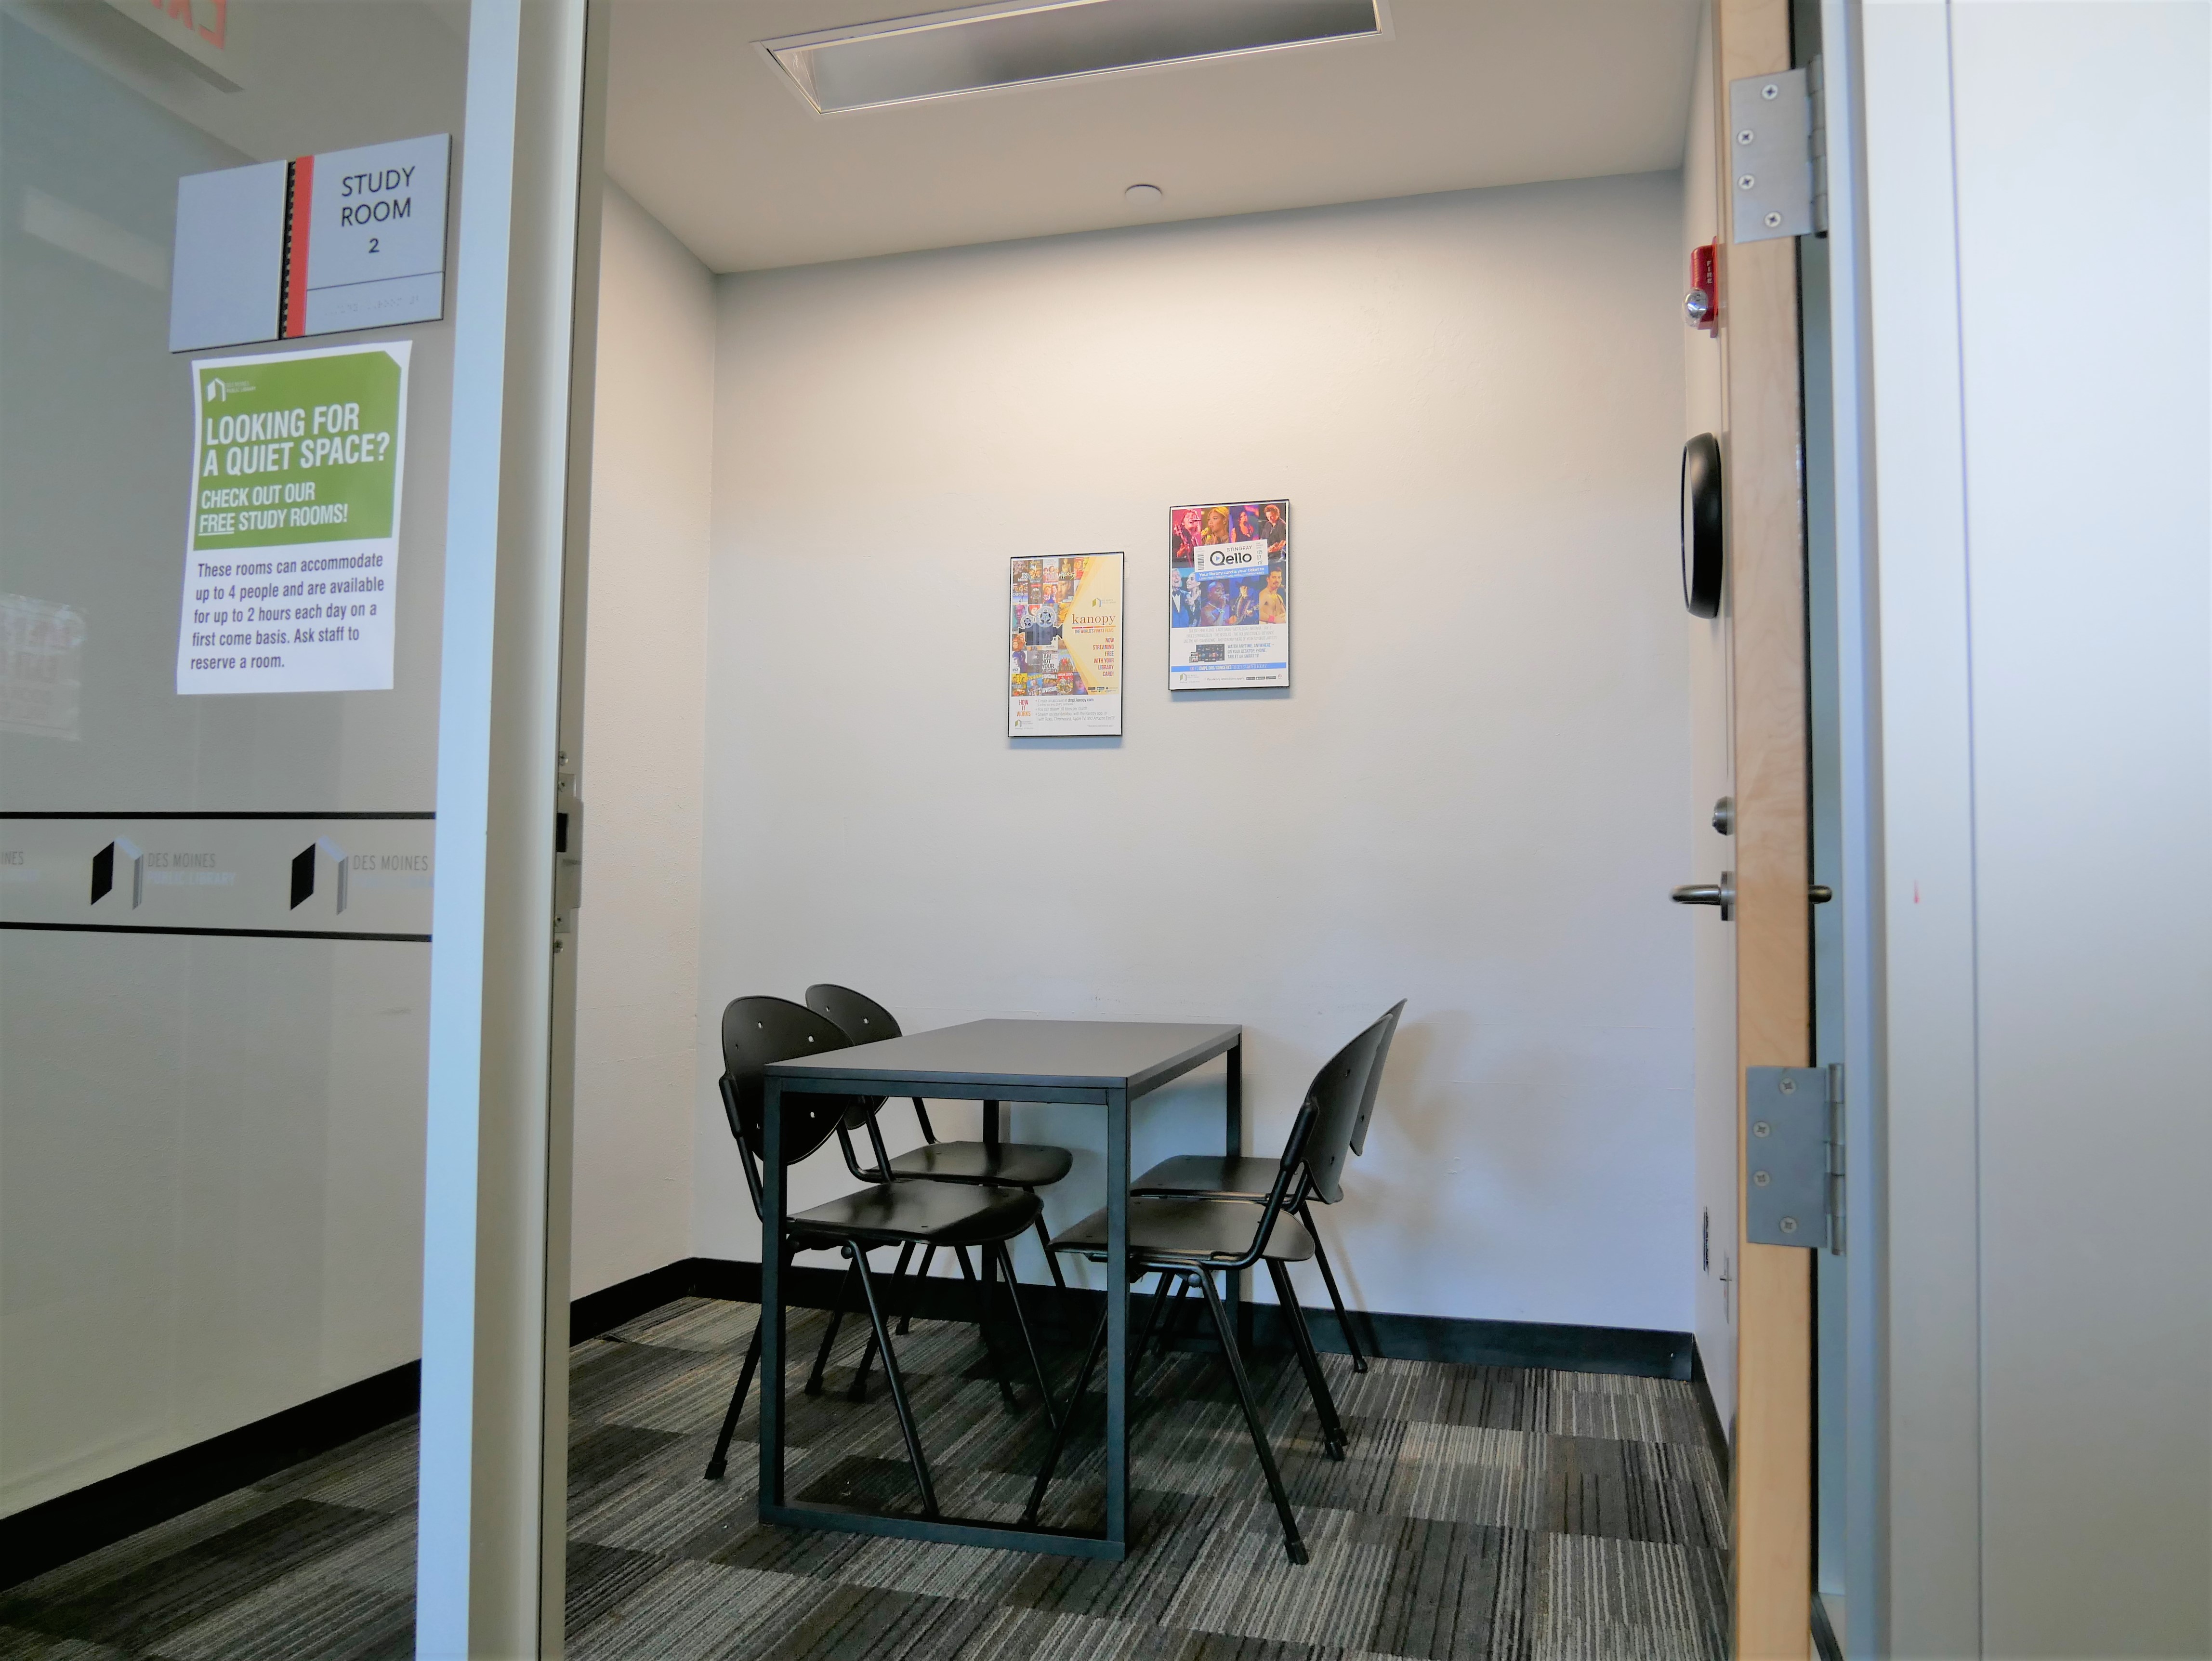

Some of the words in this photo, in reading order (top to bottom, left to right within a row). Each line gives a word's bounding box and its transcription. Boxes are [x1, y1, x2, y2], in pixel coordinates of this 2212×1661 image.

[342, 166, 415, 197] STUDY
[342, 197, 411, 227] ROOM
[369, 238, 380, 253] 2
[206, 409, 305, 445] LOOKING
[313, 403, 359, 435] FOR
[203, 449, 219, 476] A
[226, 442, 294, 476] QUIET
[300, 432, 390, 469] SPACE?
[201, 488, 249, 509] CHECK
[252, 485, 282, 506] OUT
[284, 482, 316, 503] OUR
[199, 513, 235, 533] FREE
[238, 509, 287, 531] STUDY
[290, 503, 348, 527] ROOMS!
[198, 563, 232, 577] These
[236, 562, 273, 576] rooms
[276, 561, 297, 573] can
[301, 554, 383, 572] accommodate
[1210, 551, 1252, 566] Qello
[196, 589, 210, 603] up
[214, 586, 224, 600] to
[228, 585, 236, 599] 4
[240, 583, 279, 602] people
[283, 581, 303, 596] and
[307, 583, 326, 595] are
[330, 577, 384, 593] available
[194, 609, 210, 623] for
[214, 612, 228, 626] up
[233, 609, 243, 622] to
[247, 607, 255, 621] 2
[259, 607, 291, 621] hours
[295, 604, 322, 620] each
[326, 603, 347, 620] day
[351, 604, 365, 617] on
[369, 604, 377, 616] a
[1072, 614, 1116, 625] kanopy
[192, 632, 215, 646] first
[219, 633, 251, 646] come
[256, 630, 290, 645] basis.
[294, 628, 315, 643] Ask
[318, 626, 344, 642] staff
[348, 627, 359, 641] to
[190, 657, 236, 670] reserve
[240, 657, 247, 668] a
[251, 656, 285, 669] room.
[148, 853, 169, 867] DES
[173, 853, 216, 868] MOINES
[353, 855, 376, 870] DES
[381, 855, 428, 870] MOINES
